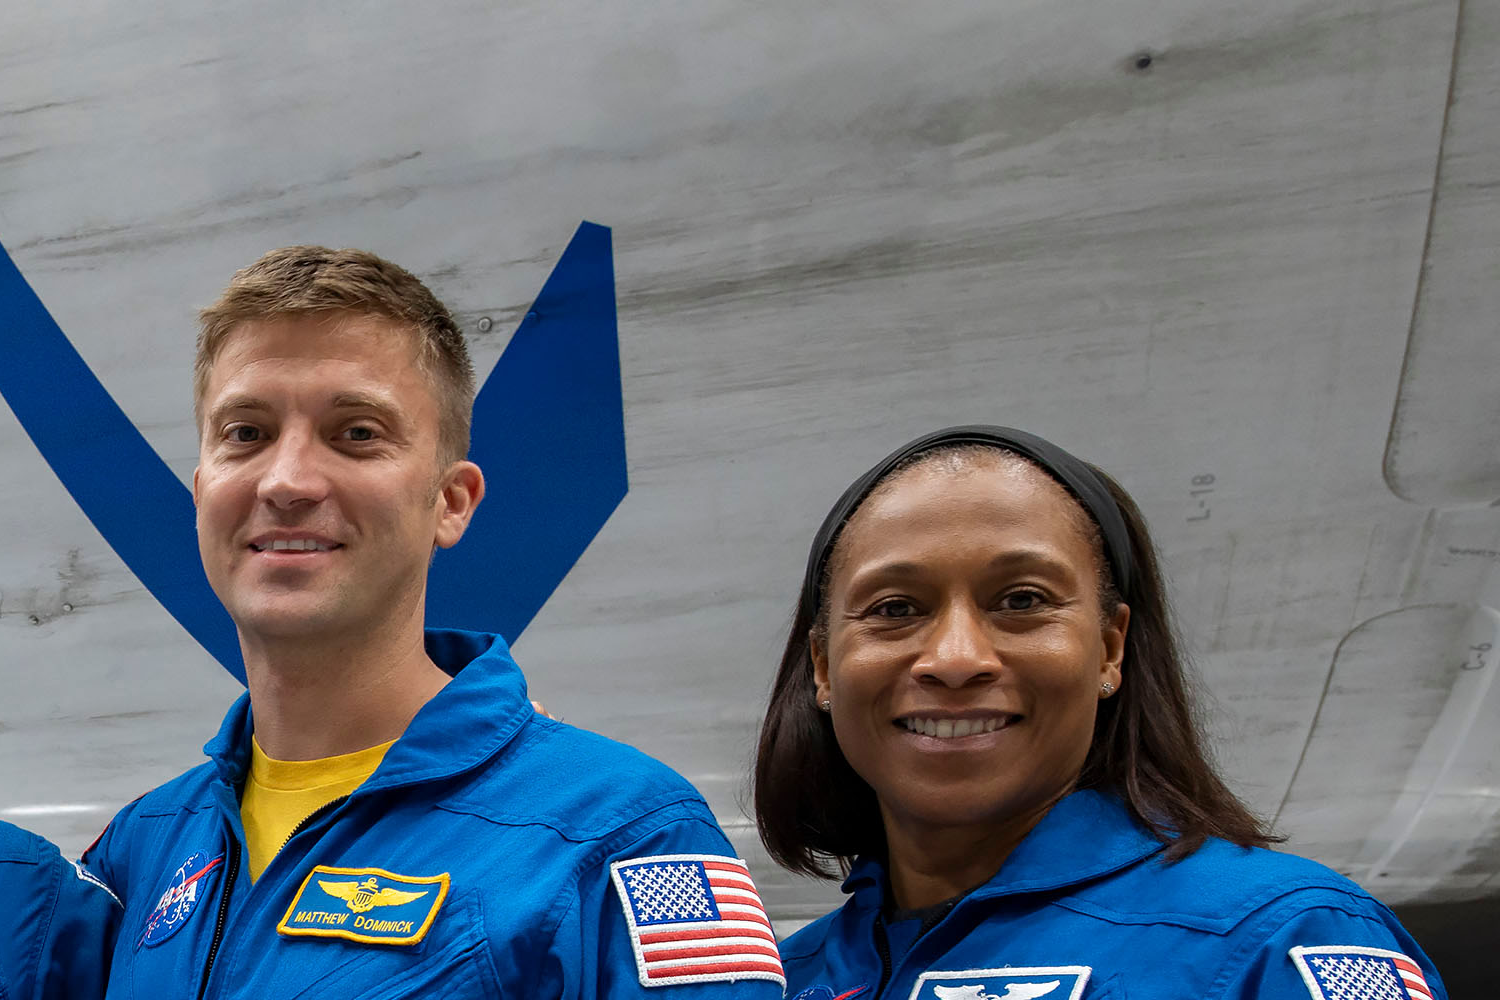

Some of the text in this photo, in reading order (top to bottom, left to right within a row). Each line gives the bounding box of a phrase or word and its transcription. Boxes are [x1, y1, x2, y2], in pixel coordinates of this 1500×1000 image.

[1187, 473, 1216, 523] L-18
[294, 911, 414, 933] MATTHEW DOMINICK
